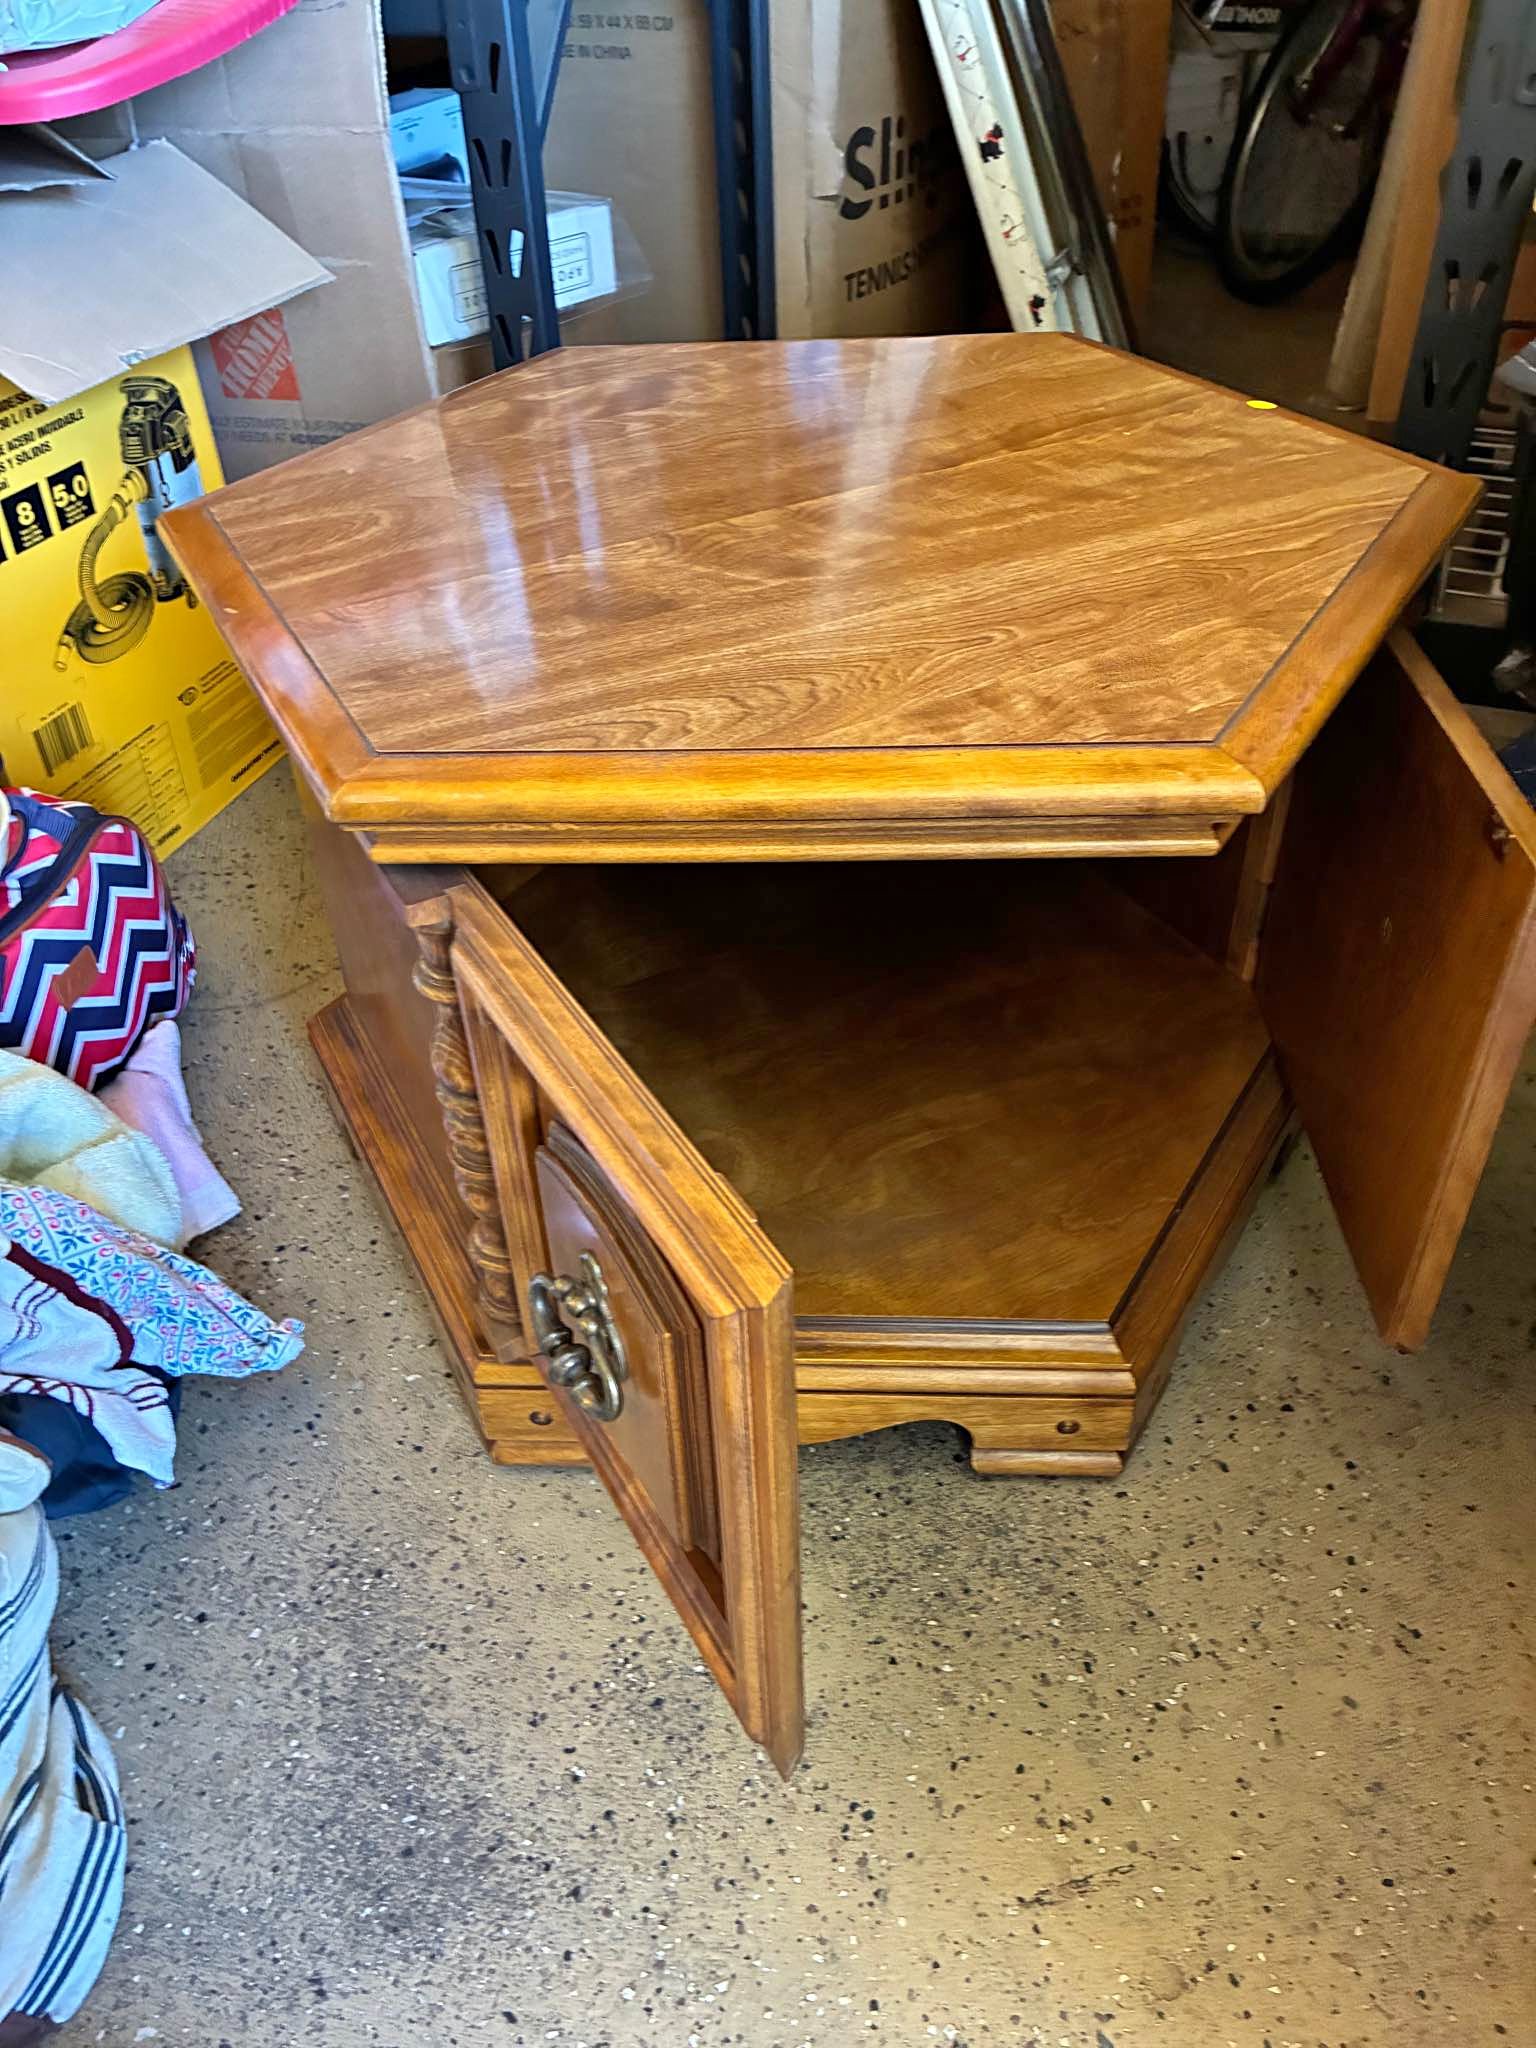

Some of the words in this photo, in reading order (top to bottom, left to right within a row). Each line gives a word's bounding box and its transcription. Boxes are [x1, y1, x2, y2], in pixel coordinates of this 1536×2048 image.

[623, 14, 634, 30] X
[593, 44, 632, 59] CHINA
[52, 474, 89, 508] 5.0
[16, 501, 36, 526] 8
